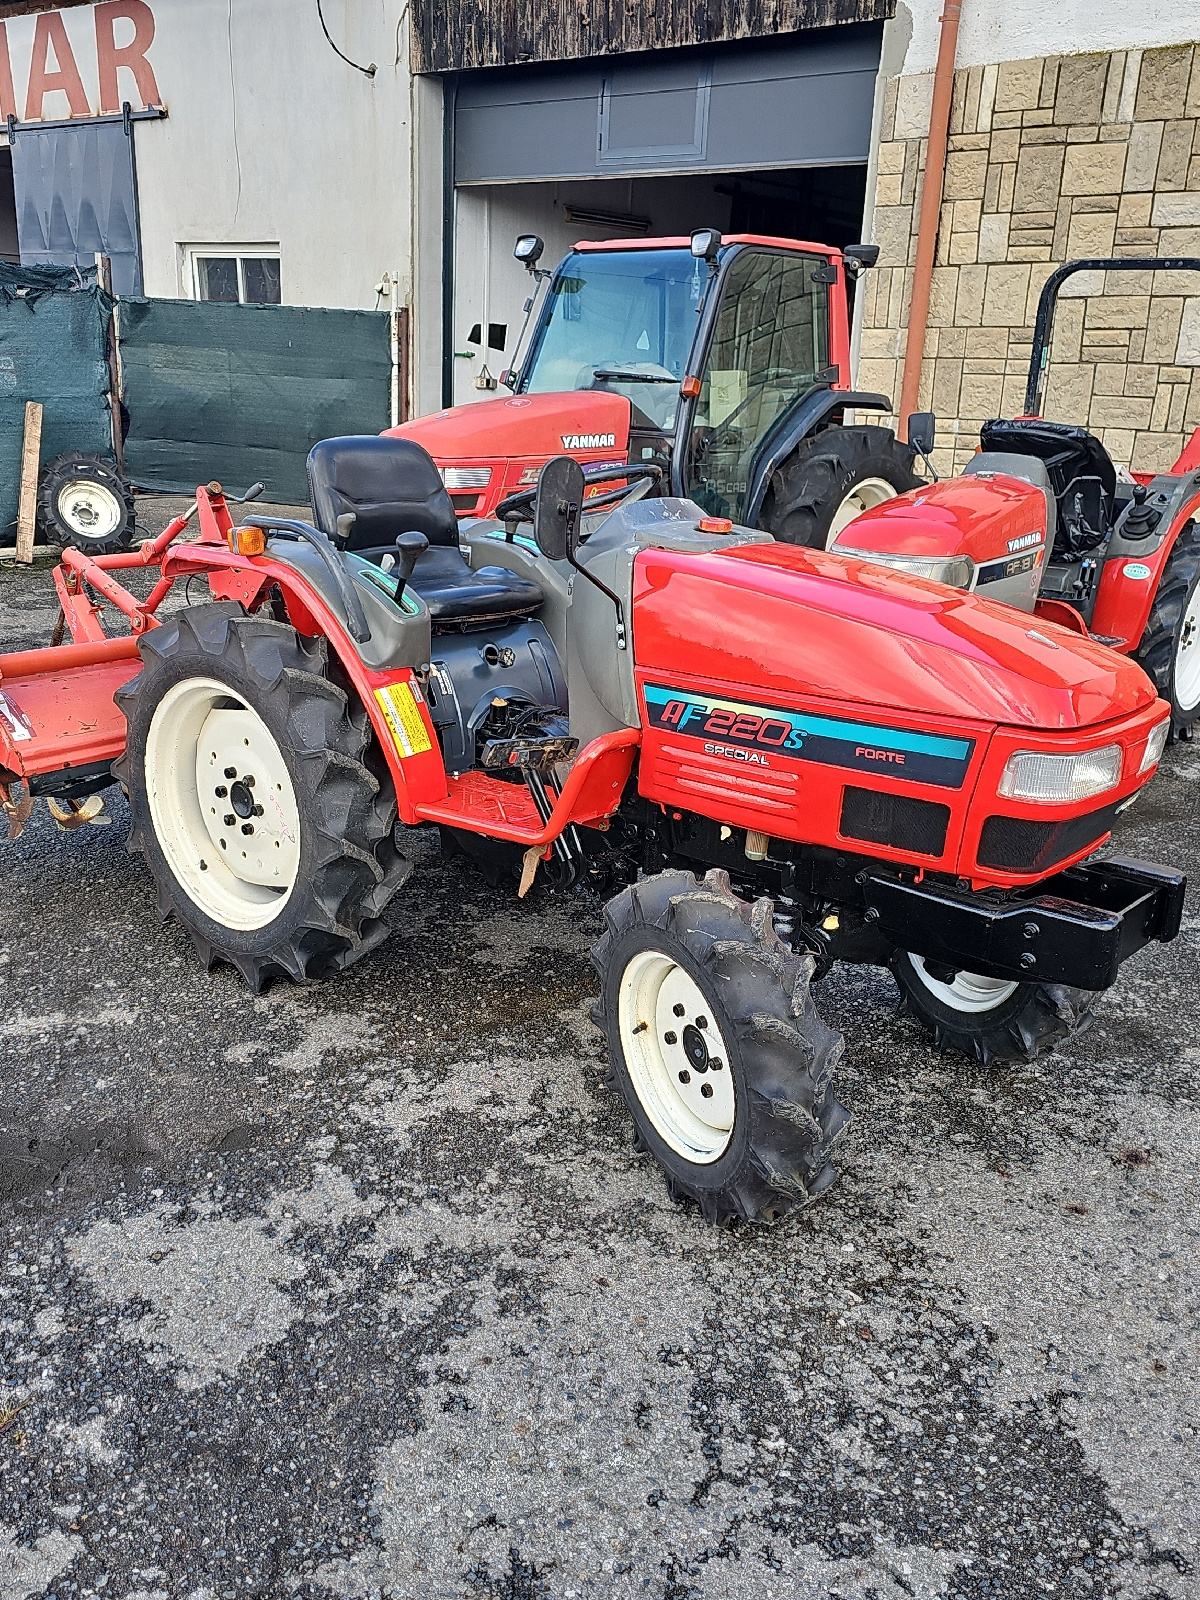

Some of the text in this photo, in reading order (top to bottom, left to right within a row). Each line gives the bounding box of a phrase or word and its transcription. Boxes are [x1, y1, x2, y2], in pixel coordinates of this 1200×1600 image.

[0, 0, 163, 122] AR
[561, 434, 615, 449] YANMAR
[1007, 532, 1042, 553] YANMAR
[703, 743, 770, 766] SPECIAL
[855, 747, 905, 765] FORTE
